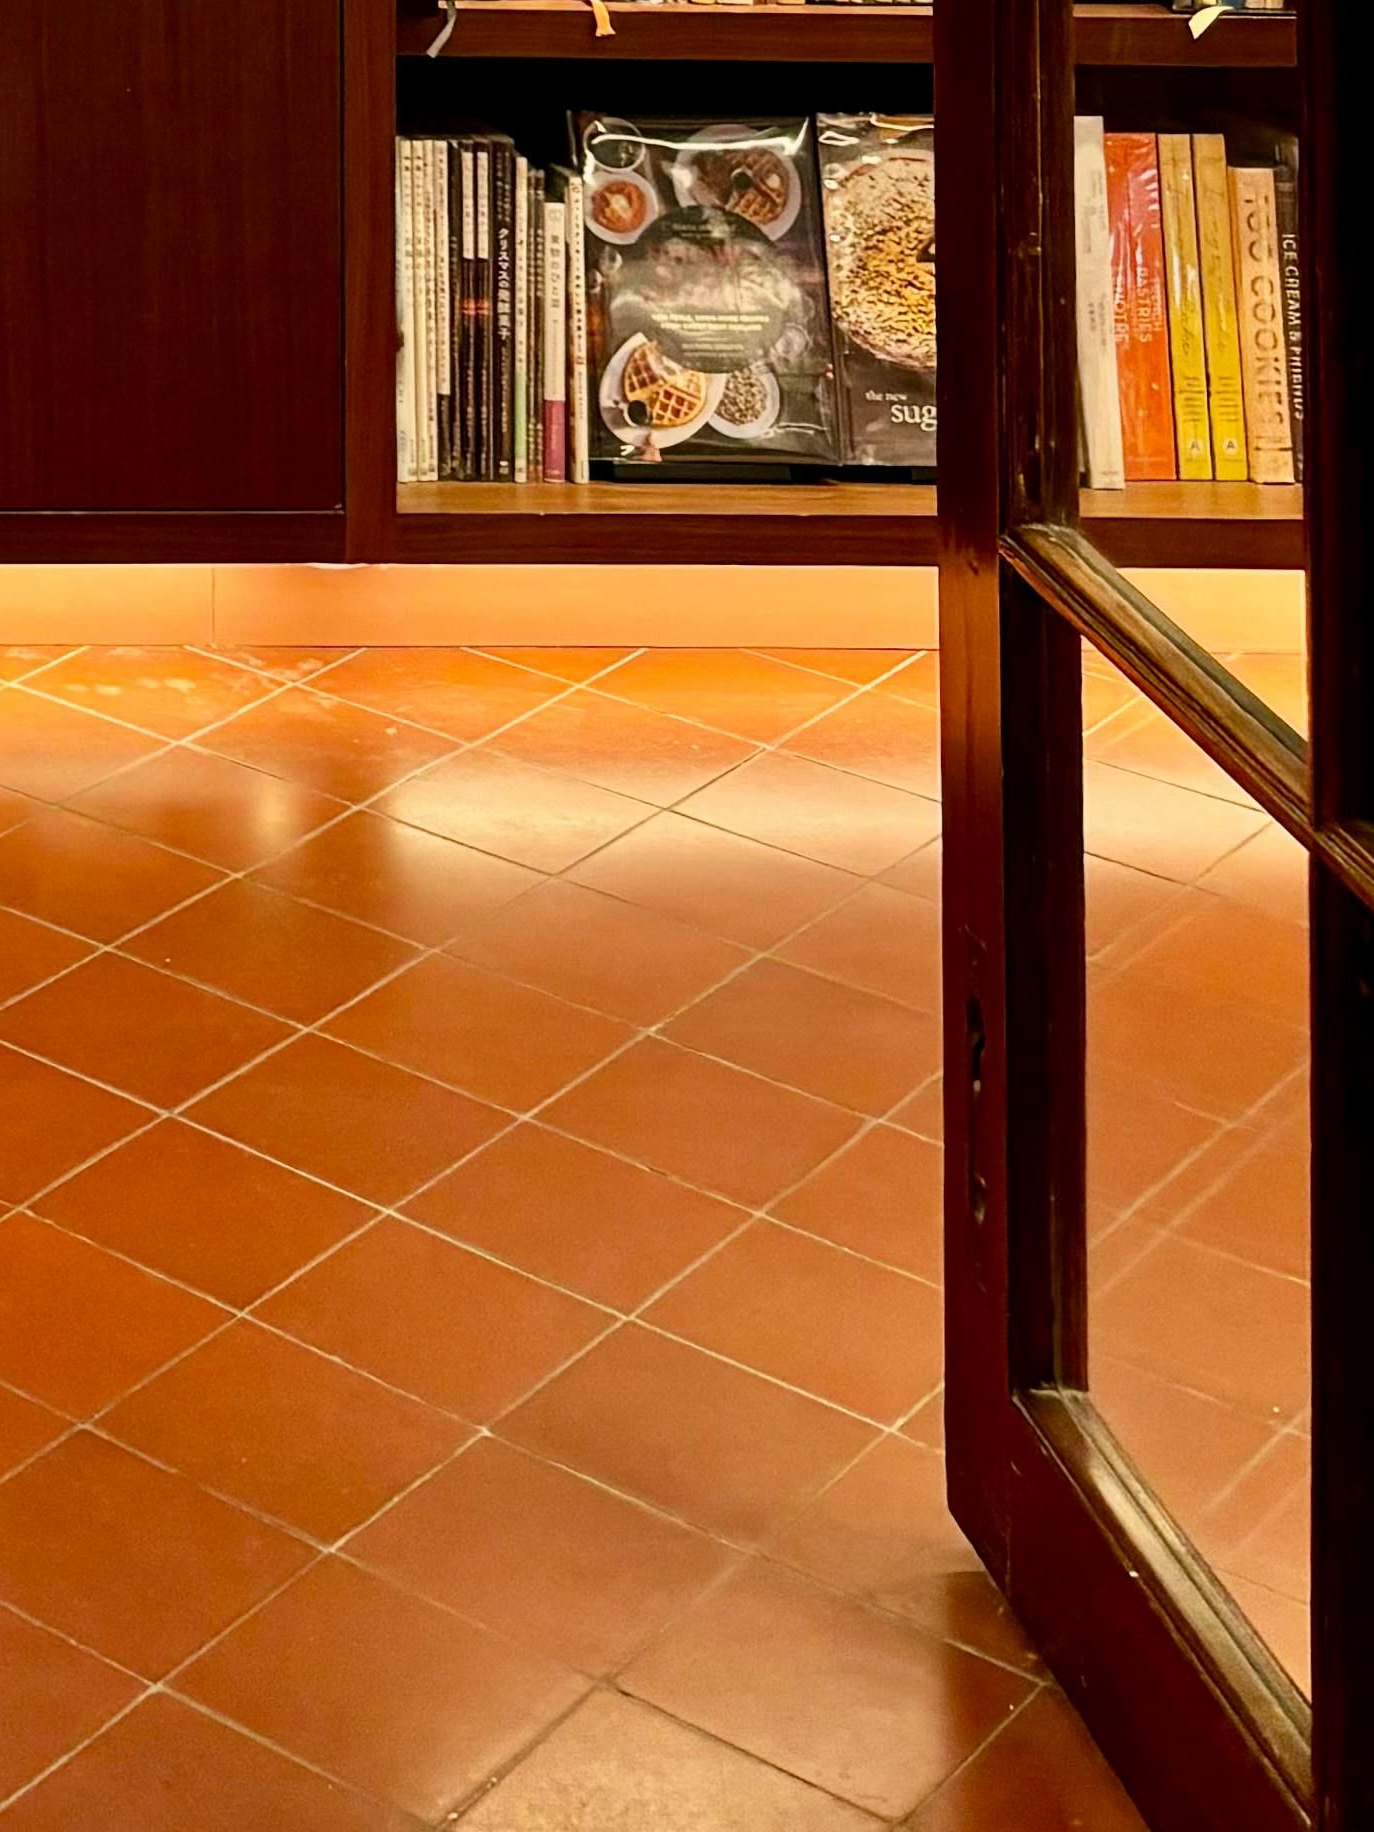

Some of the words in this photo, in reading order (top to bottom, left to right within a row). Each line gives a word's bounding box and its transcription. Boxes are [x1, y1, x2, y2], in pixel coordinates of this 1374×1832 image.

[1281, 232, 1297, 260] ICE
[1136, 266, 1153, 343] PASTRIES
[1283, 265, 1301, 326] CREAM
[1251, 275, 1284, 426] COOKIES
[865, 391, 883, 401] the
[885, 393, 908, 401] new
[891, 403, 937, 431] sug
